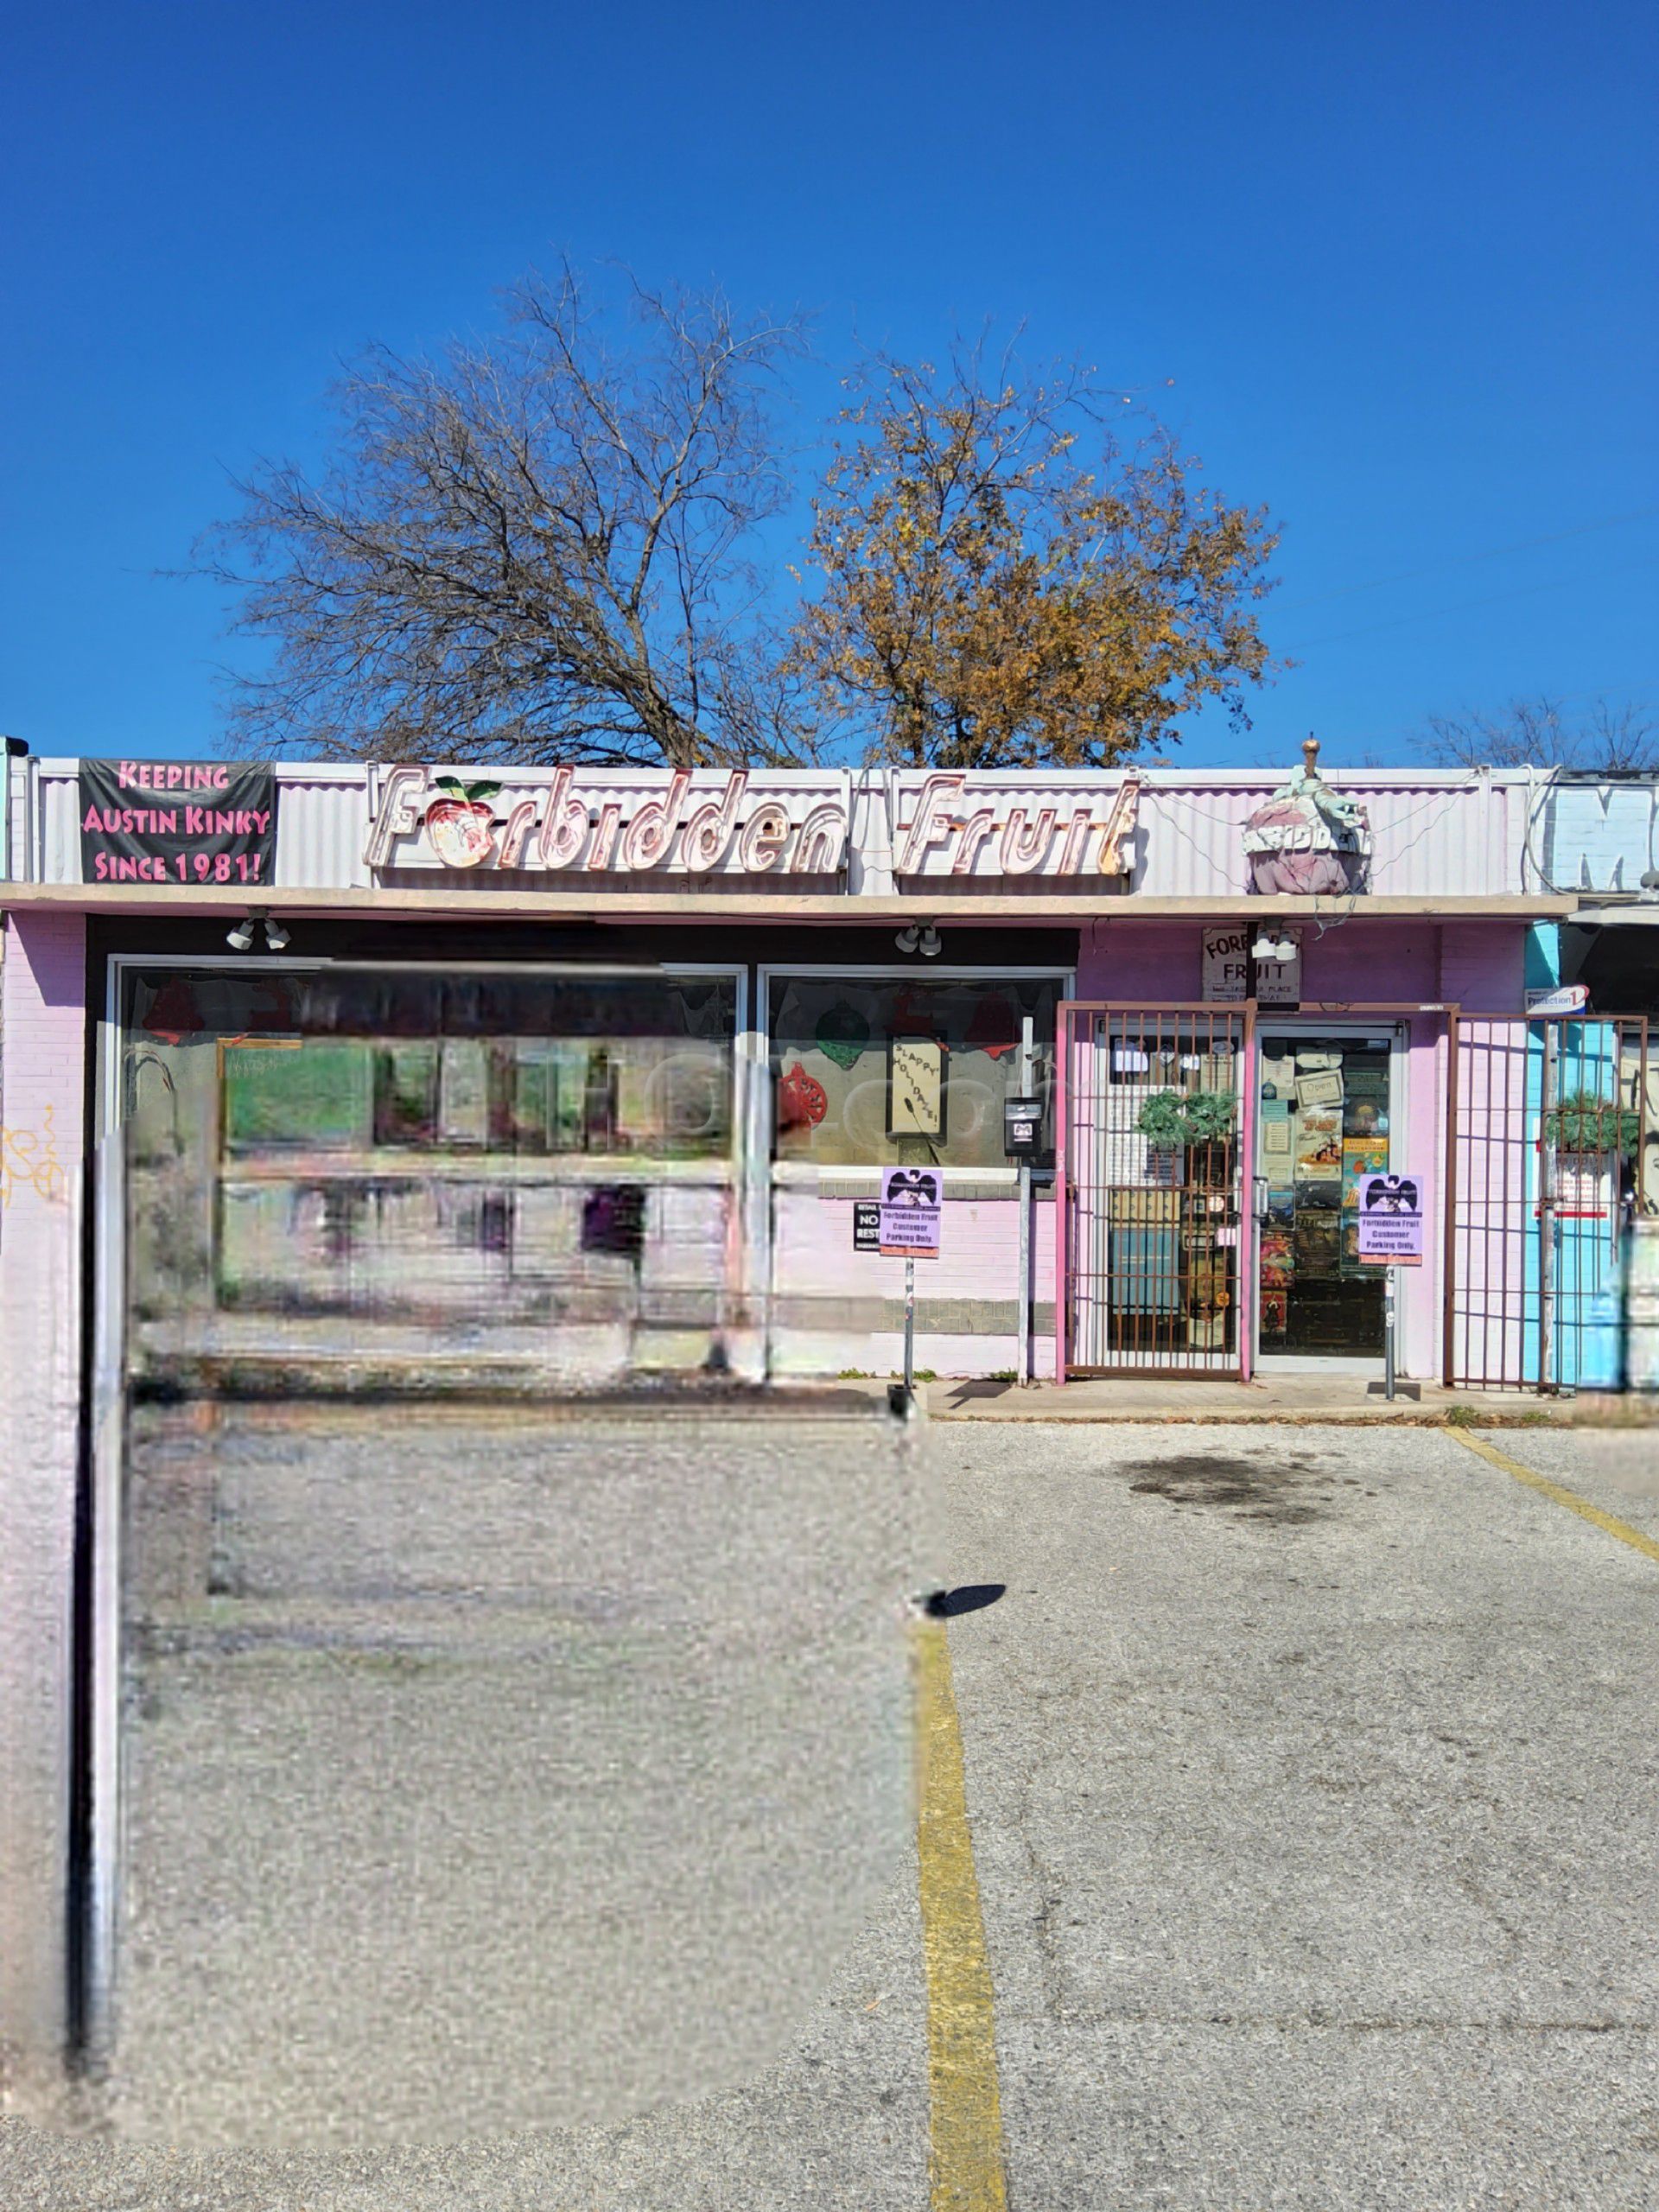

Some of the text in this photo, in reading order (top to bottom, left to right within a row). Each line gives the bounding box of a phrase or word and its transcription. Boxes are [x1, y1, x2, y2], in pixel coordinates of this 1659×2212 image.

[118, 760, 229, 789] KEEPING
[83, 804, 270, 835] AUSTIN KINKY
[897, 773, 1141, 874] Fruit
[95, 851, 262, 881] SINCE 1981!
[860, 1214, 879, 1225] NO
[886, 1233, 915, 1243] Parking
[1367, 1241, 1395, 1249] Parking
